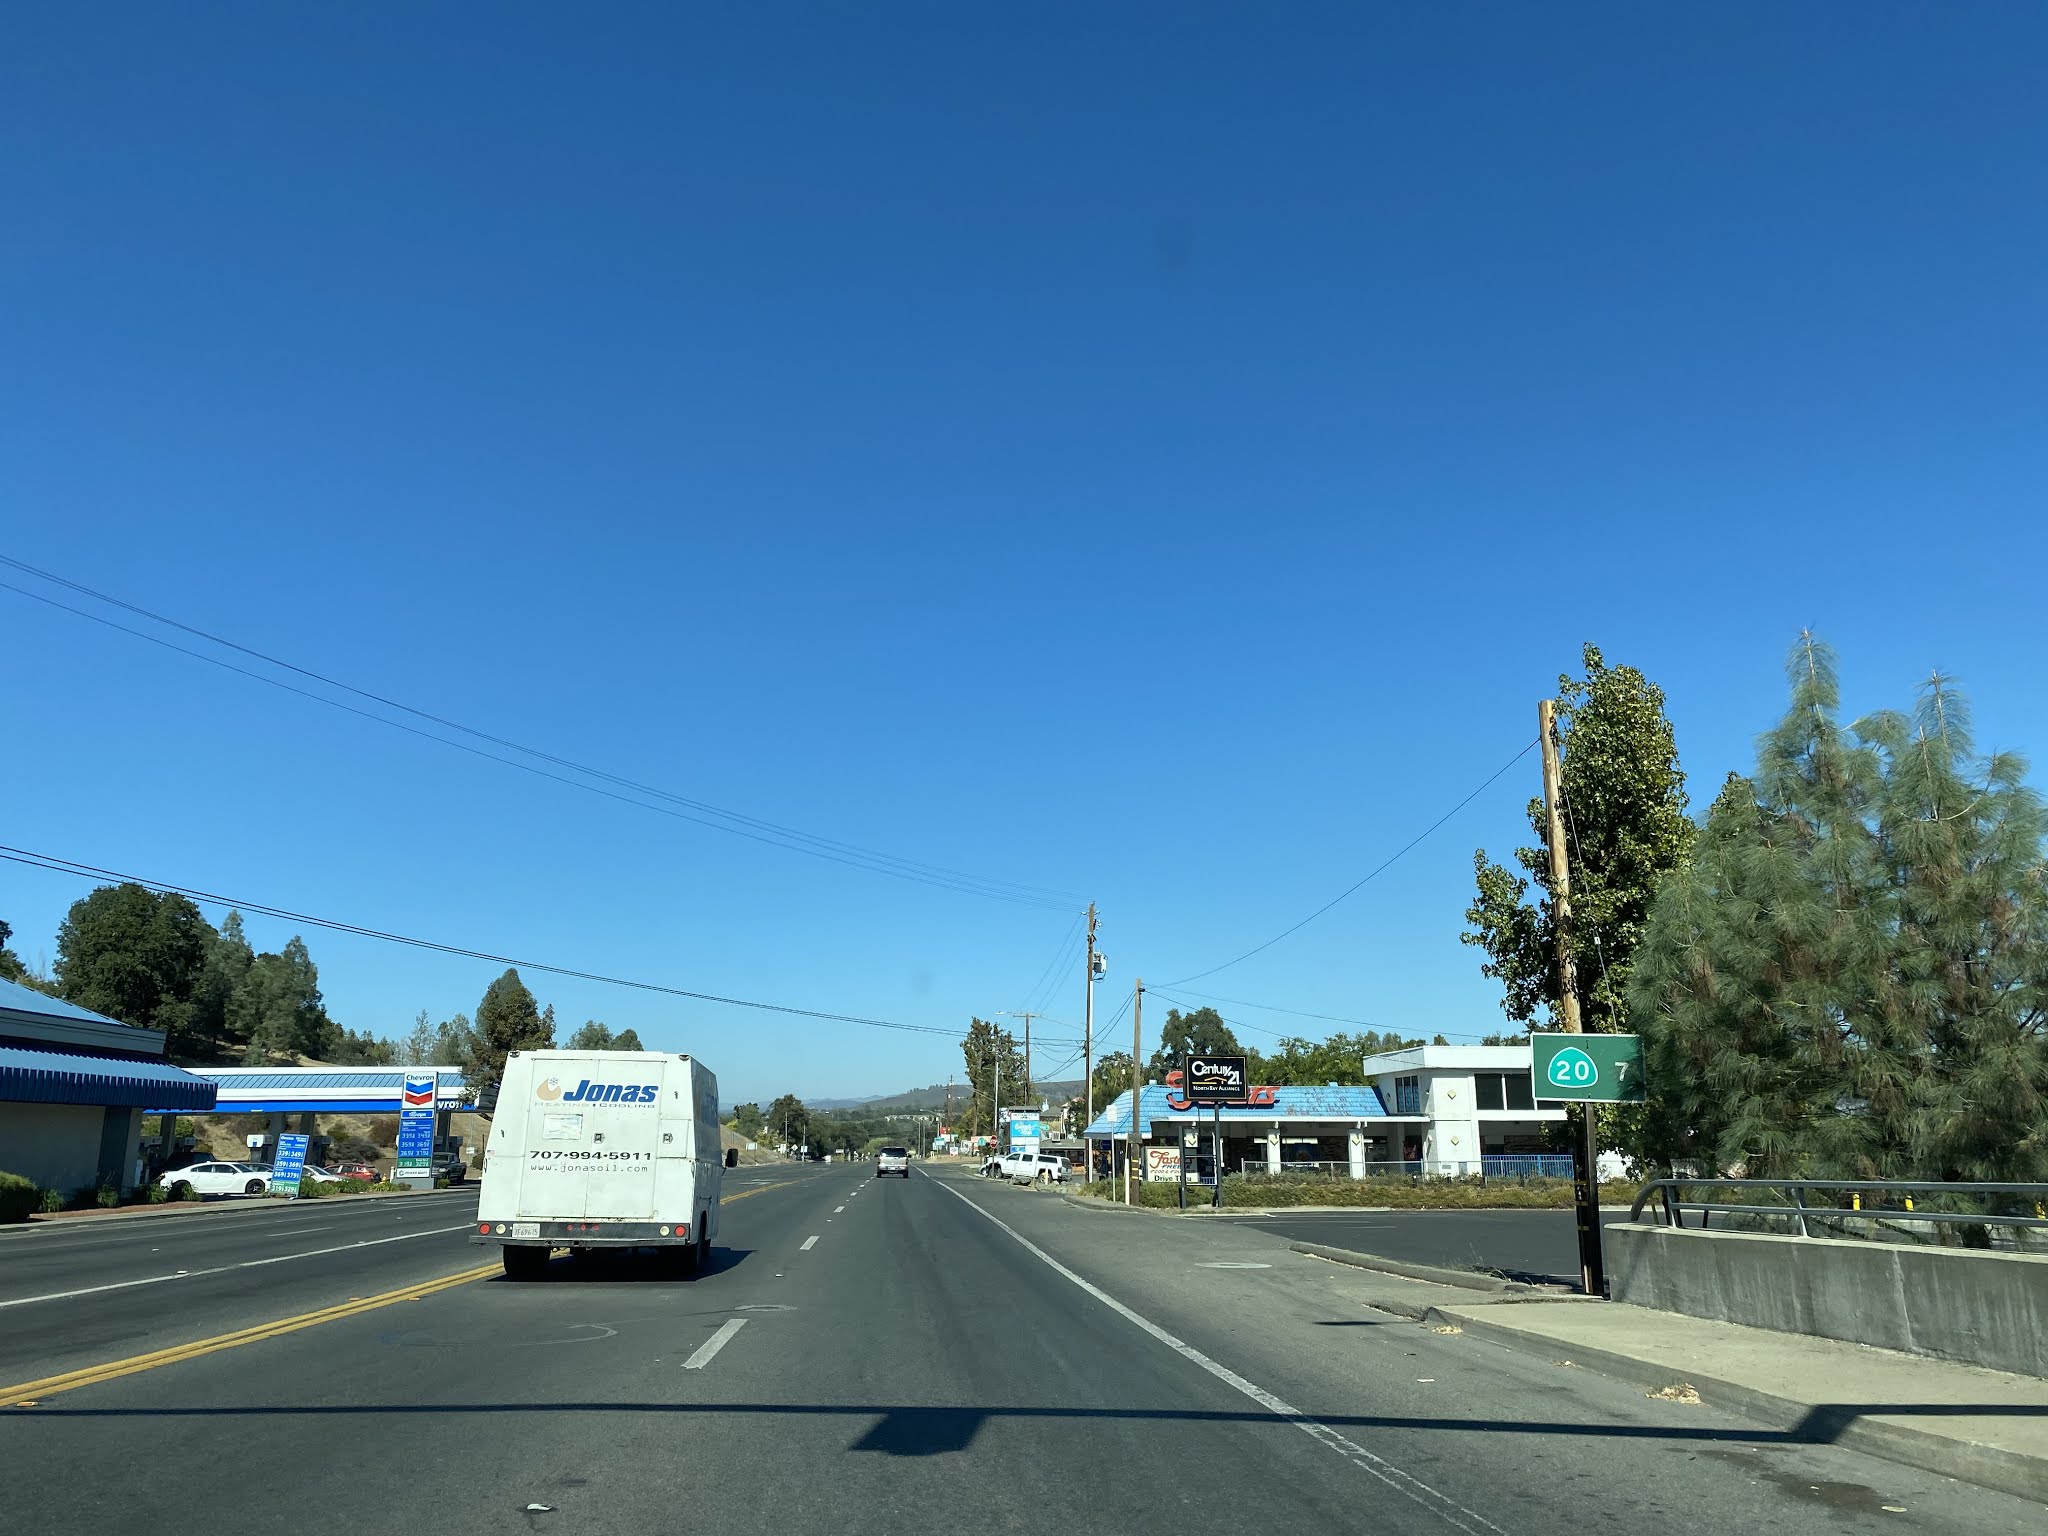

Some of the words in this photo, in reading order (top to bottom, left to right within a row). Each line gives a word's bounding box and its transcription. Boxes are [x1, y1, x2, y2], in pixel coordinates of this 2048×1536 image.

[1191, 1061, 1232, 1077] Century
[1556, 1060, 1589, 1080] 20
[1614, 1061, 1629, 1081] 7
[1227, 1071, 1240, 1085] 21
[563, 1080, 659, 1102] Jonas
[531, 1164, 648, 1172] www.jonasoil.com
[1149, 1151, 1194, 1169] Fosts
